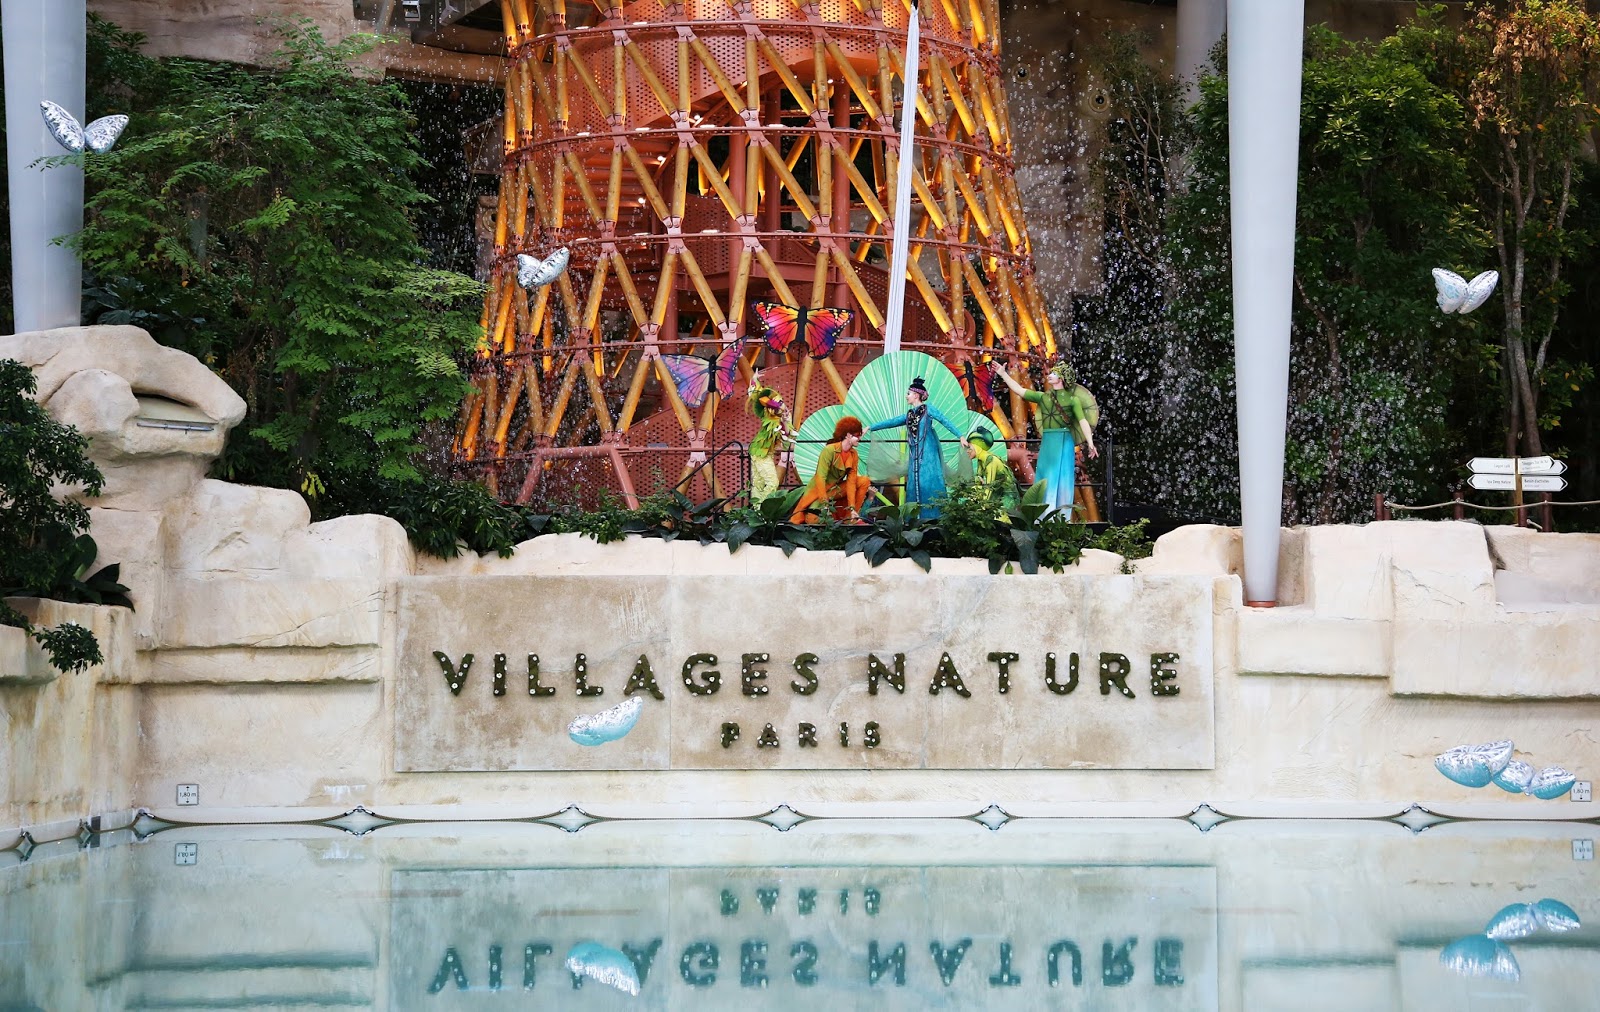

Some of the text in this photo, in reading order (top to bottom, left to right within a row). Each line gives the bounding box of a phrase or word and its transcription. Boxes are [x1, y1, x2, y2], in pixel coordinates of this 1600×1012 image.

[432, 650, 1181, 700] VILLAGES NATURE
[720, 720, 882, 750] PARIS
